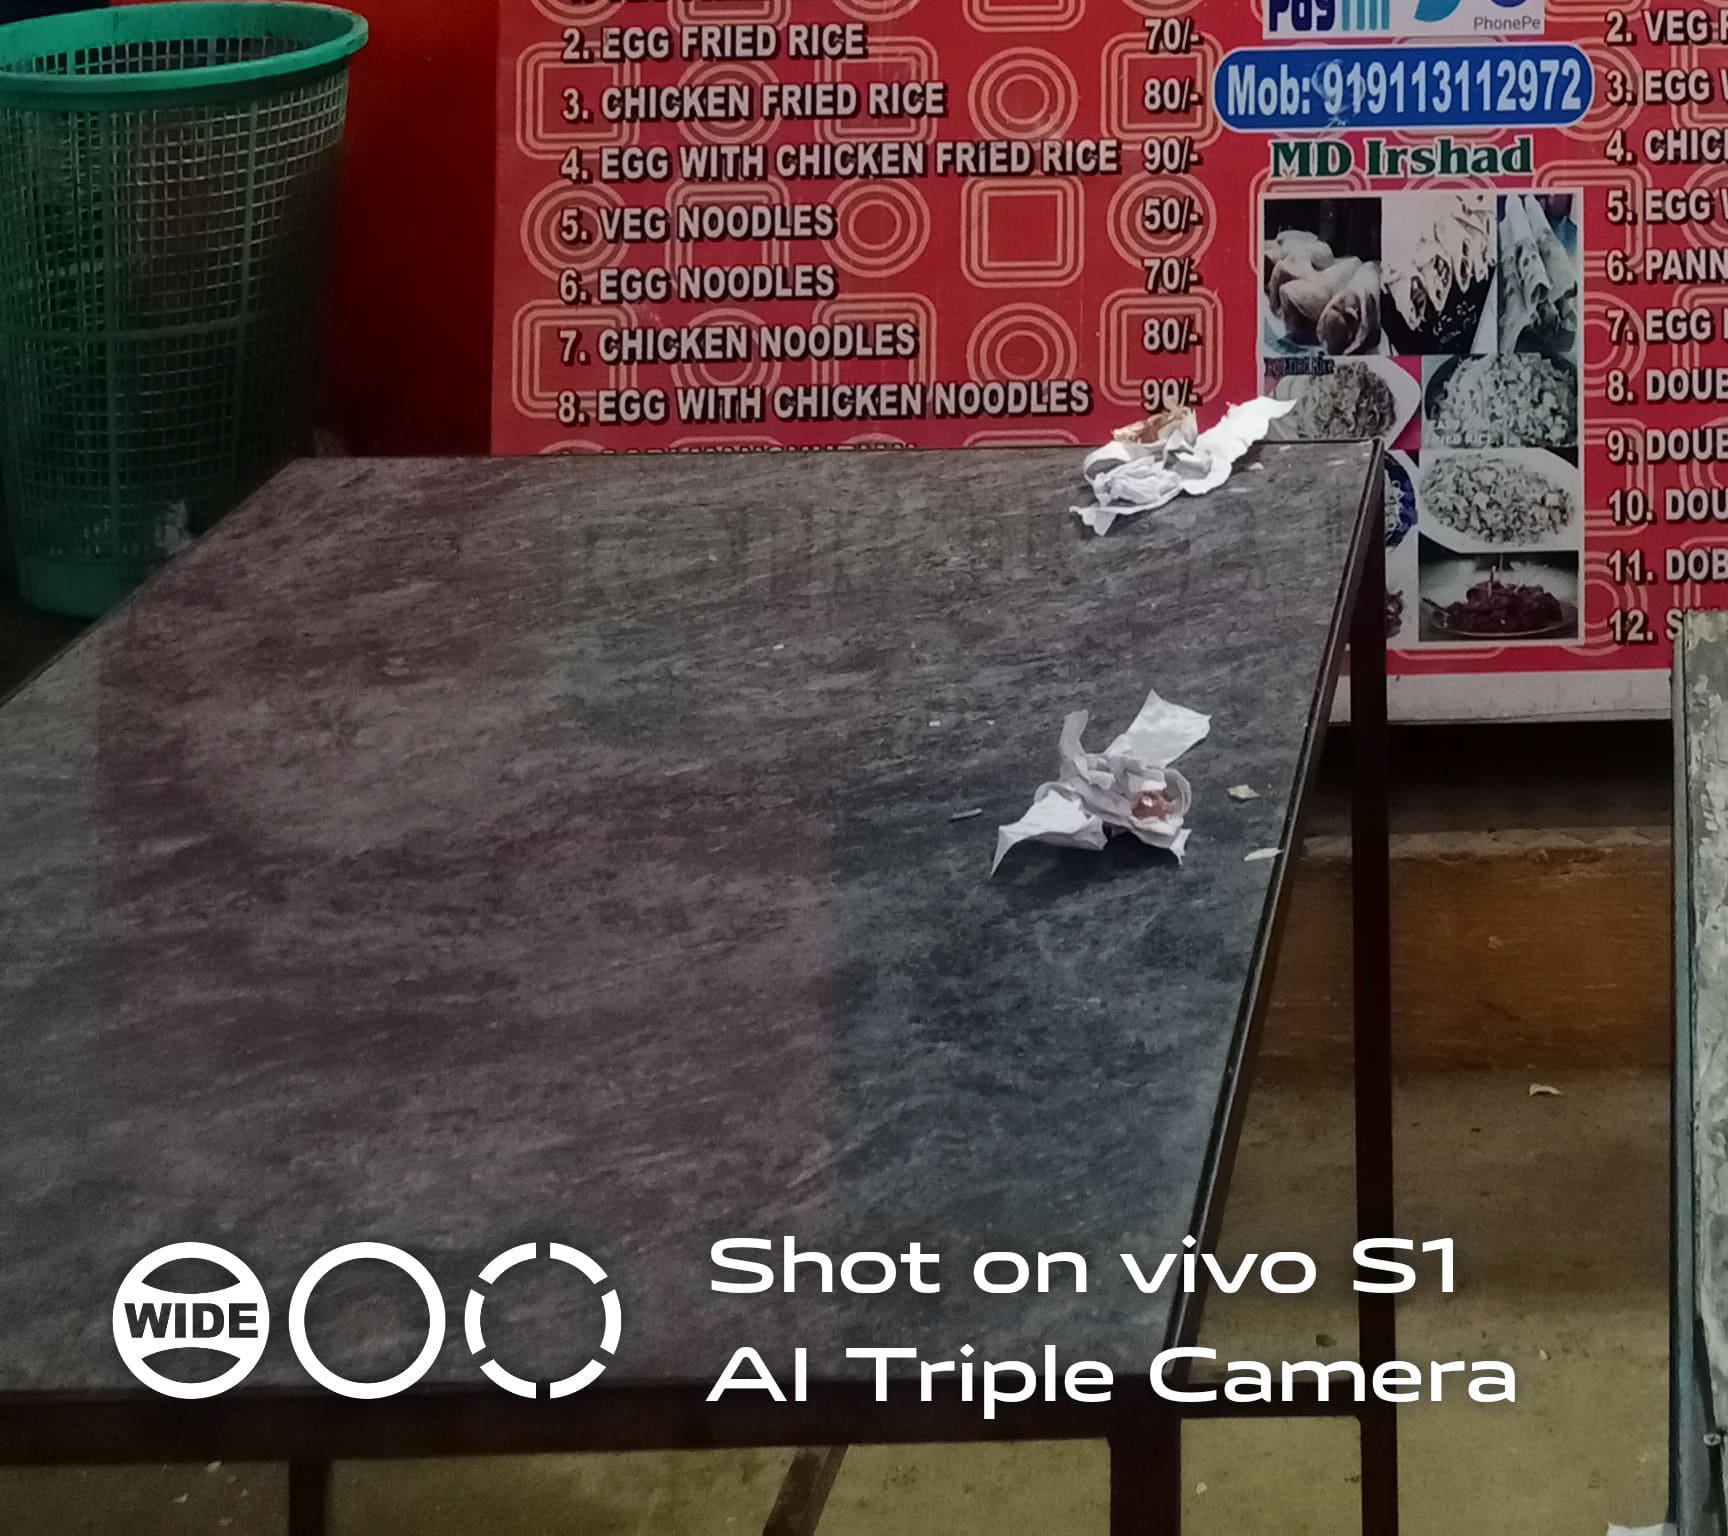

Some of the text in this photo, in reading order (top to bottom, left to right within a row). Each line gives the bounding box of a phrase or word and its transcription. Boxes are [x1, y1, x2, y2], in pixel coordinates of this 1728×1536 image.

[1474, 16, 1540, 31] PhonePe
[561, 80, 1201, 121] 3. CHICKEN FRIED RICE 80/-
[1606, 70, 1637, 104] 3.
[1644, 70, 1710, 102] EGG
[1269, 135, 1534, 177] MD Irshad
[560, 199, 1200, 242] 5. VEG NOODLES 50/-
[1606, 250, 1635, 282] 6.
[1608, 491, 1656, 524] 10.
